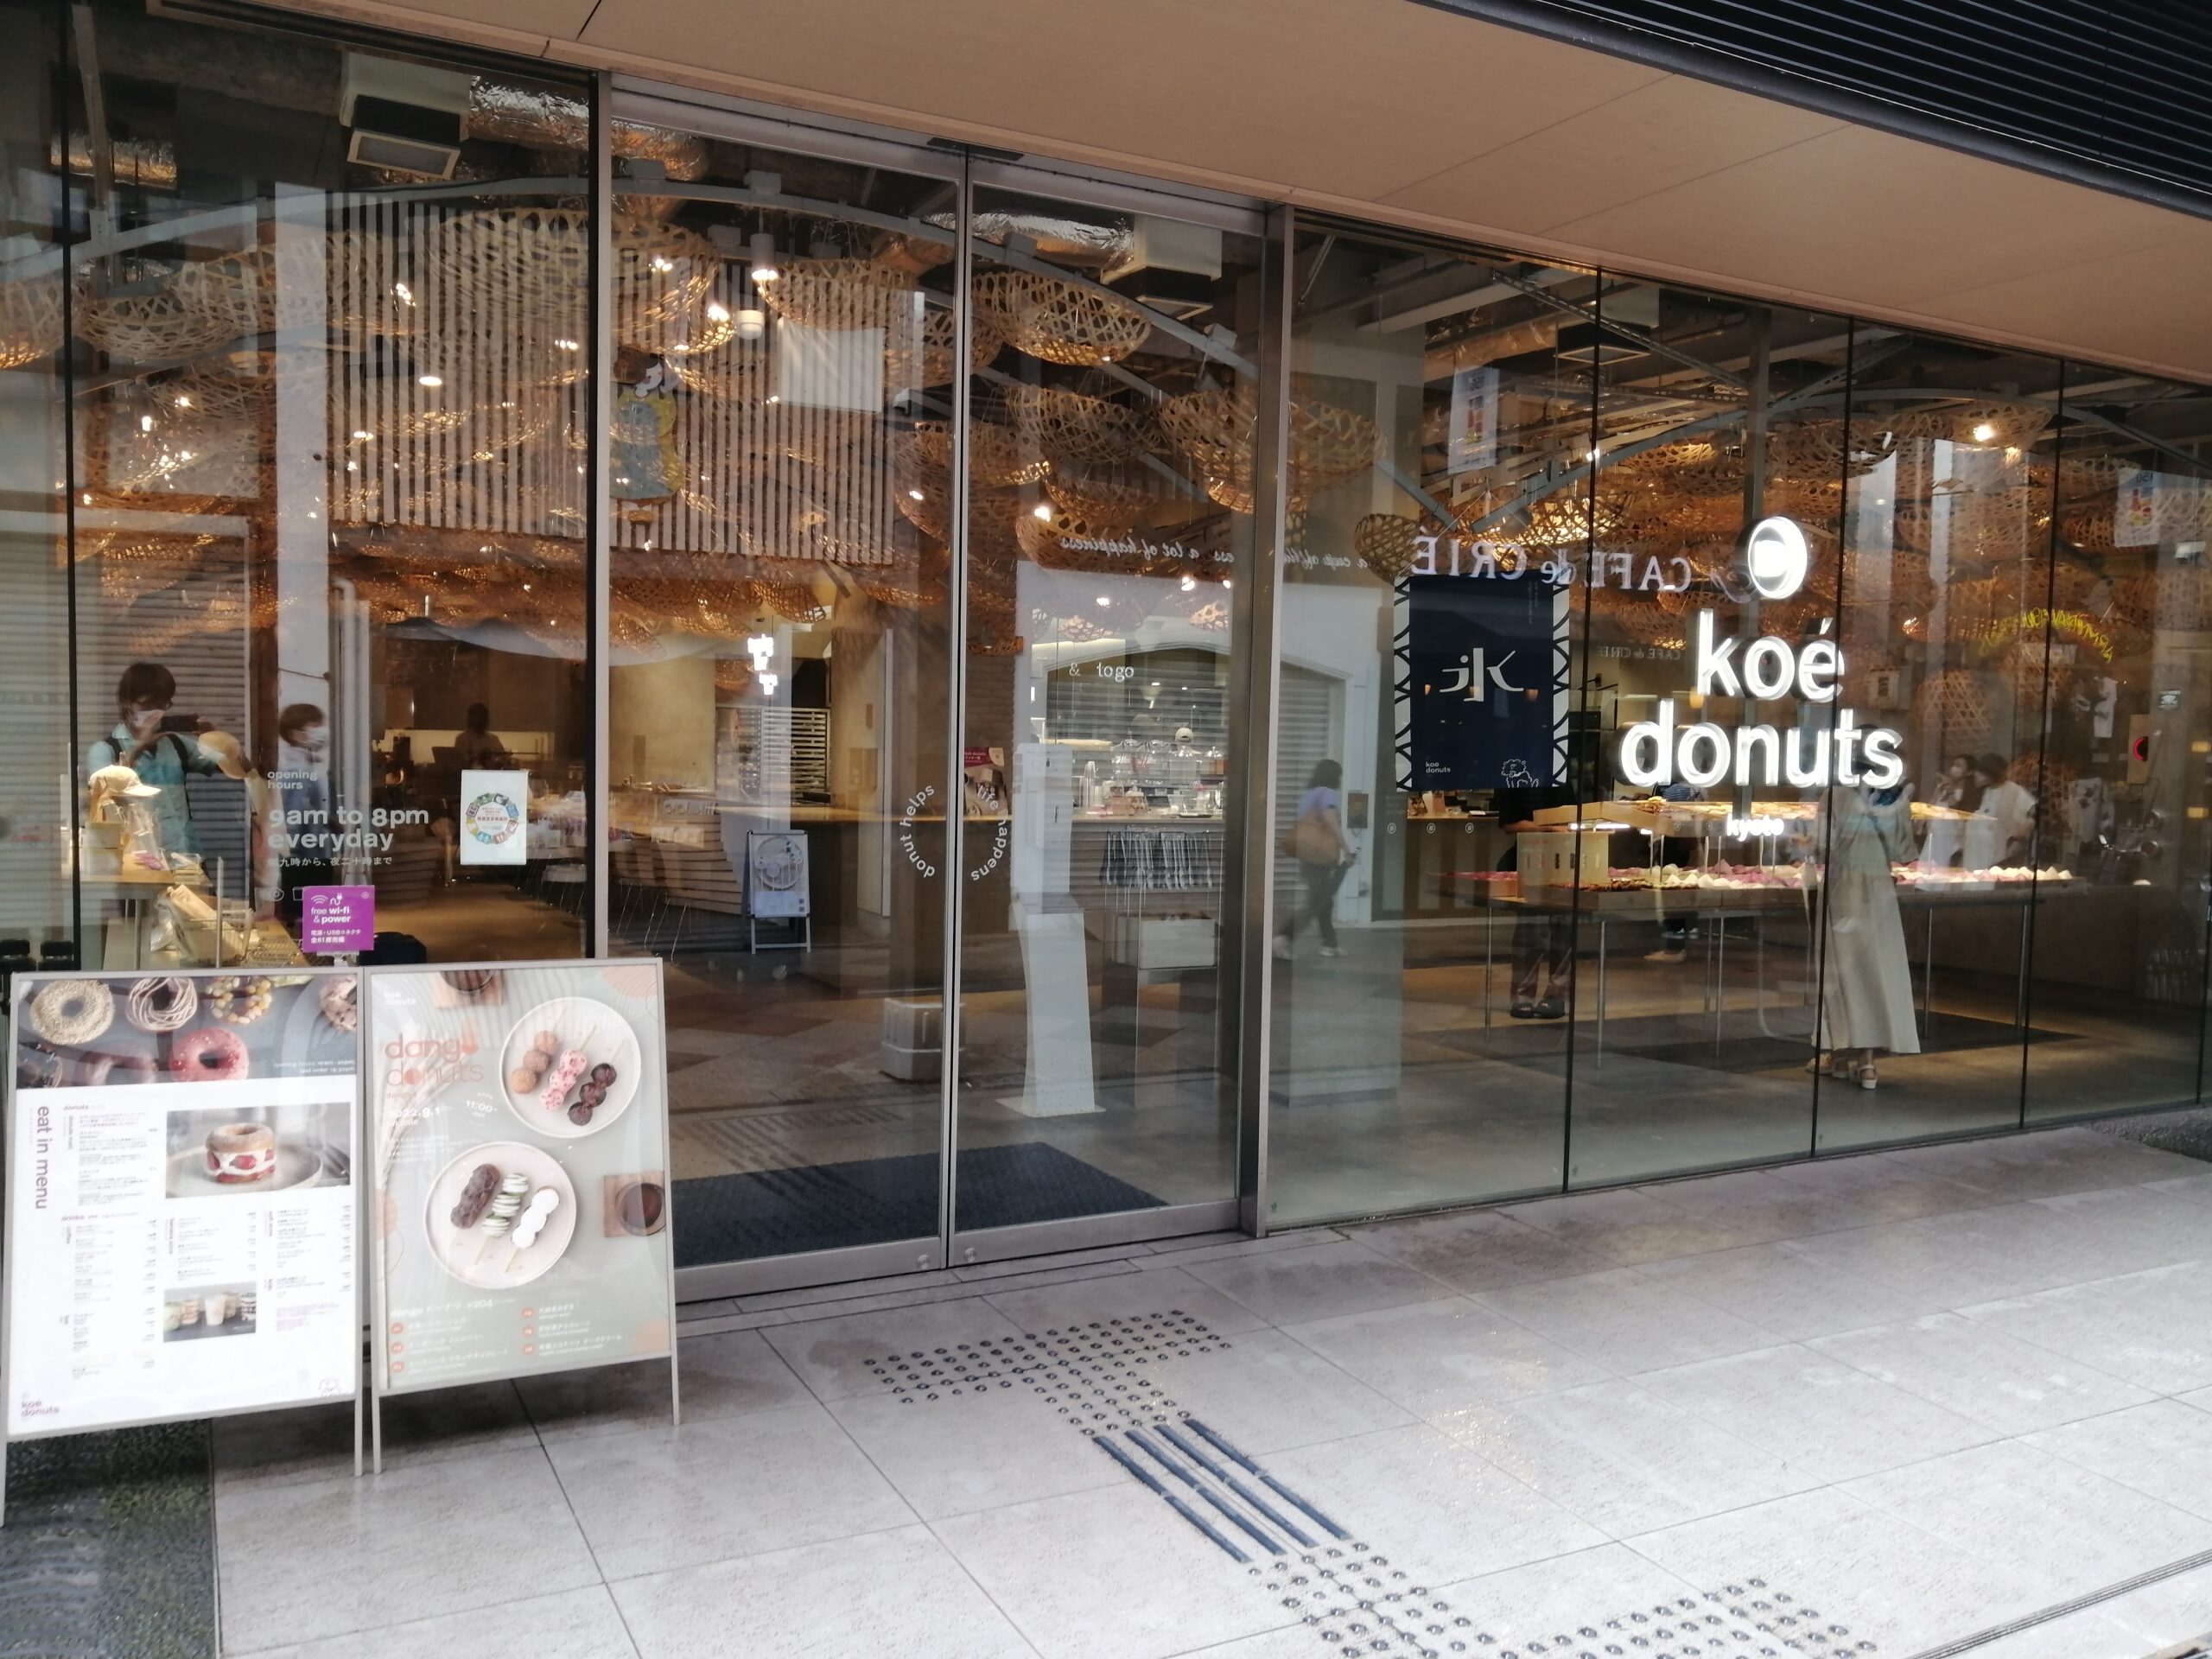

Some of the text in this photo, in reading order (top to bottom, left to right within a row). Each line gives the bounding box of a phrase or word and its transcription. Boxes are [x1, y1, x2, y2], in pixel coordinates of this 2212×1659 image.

[1697, 607, 1845, 703] koé
[1620, 698, 1904, 790] donuts
[267, 770, 318, 781] opening
[267, 780, 303, 790] hours
[976, 785, 999, 810] life
[269, 806, 429, 830] 9am to 8pm
[1726, 811, 1785, 841] kyoto
[268, 828, 393, 851] everyday
[899, 785, 935, 878] donut helps
[311, 906, 350, 915] free wi-fi
[321, 916, 351, 925] power
[35, 1105, 54, 1210] eat in menu
